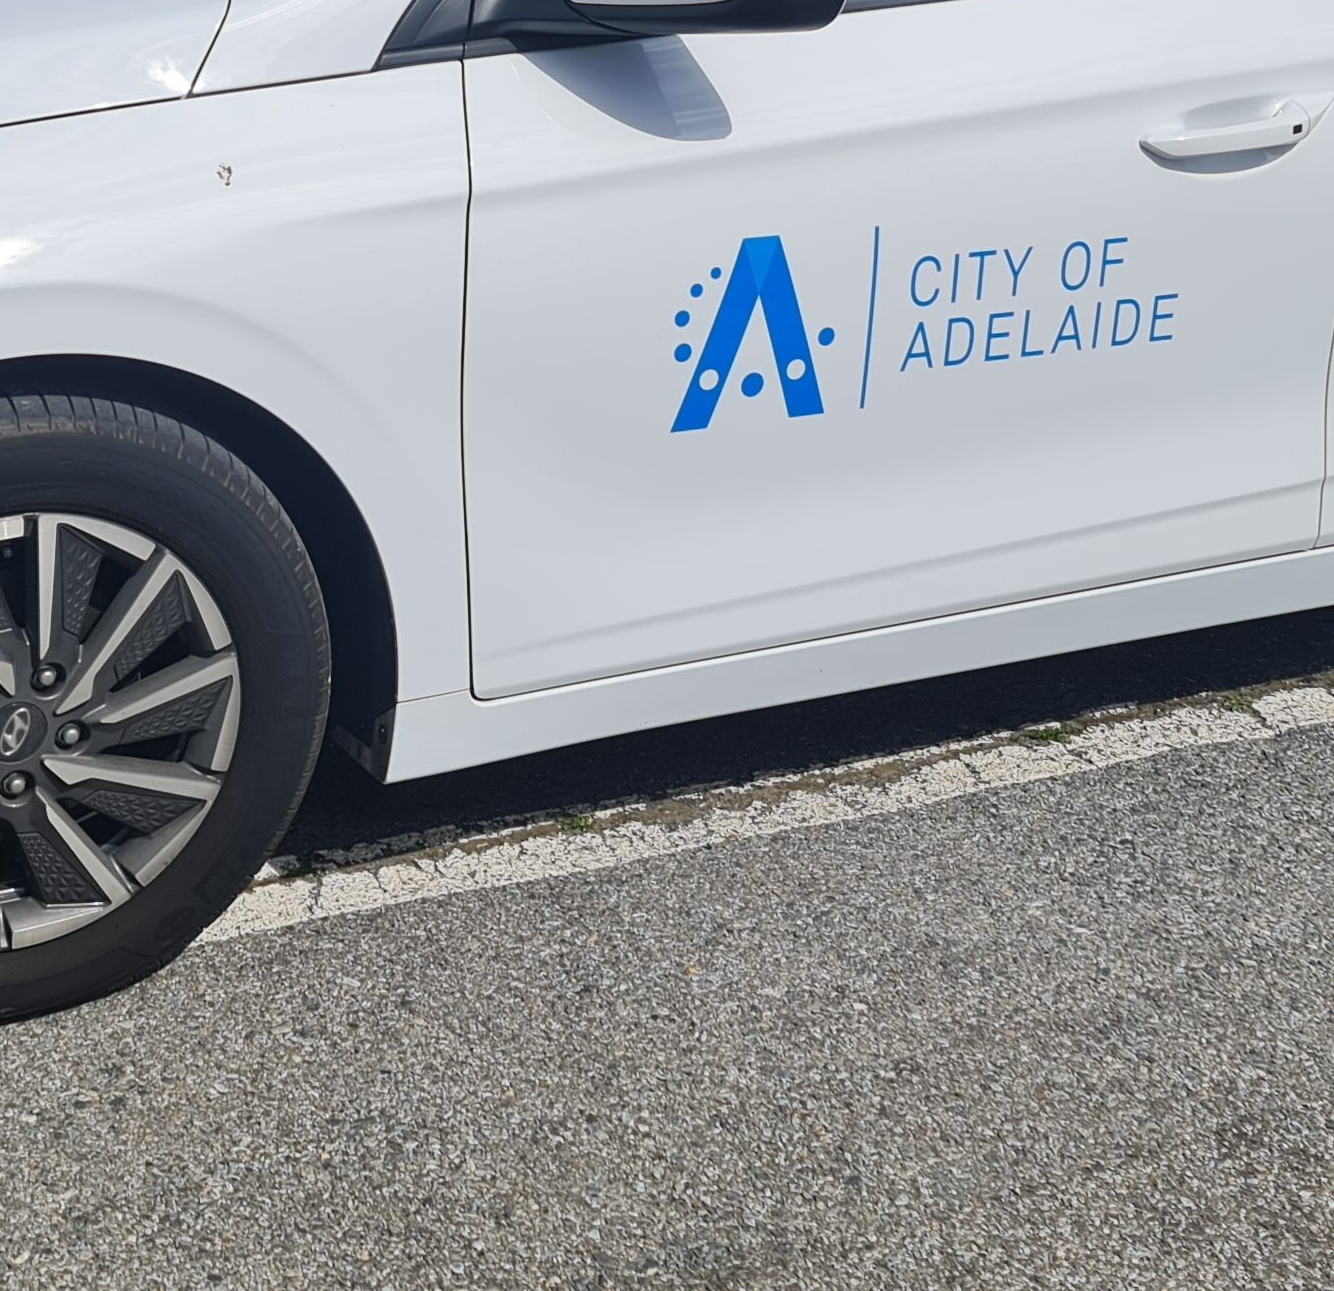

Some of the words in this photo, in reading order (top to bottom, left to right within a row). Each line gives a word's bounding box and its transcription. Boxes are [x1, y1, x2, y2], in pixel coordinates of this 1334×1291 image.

[909, 246, 1034, 308] CITY
[1059, 237, 1129, 292] OF
[899, 293, 1179, 372] ADELAIDE
